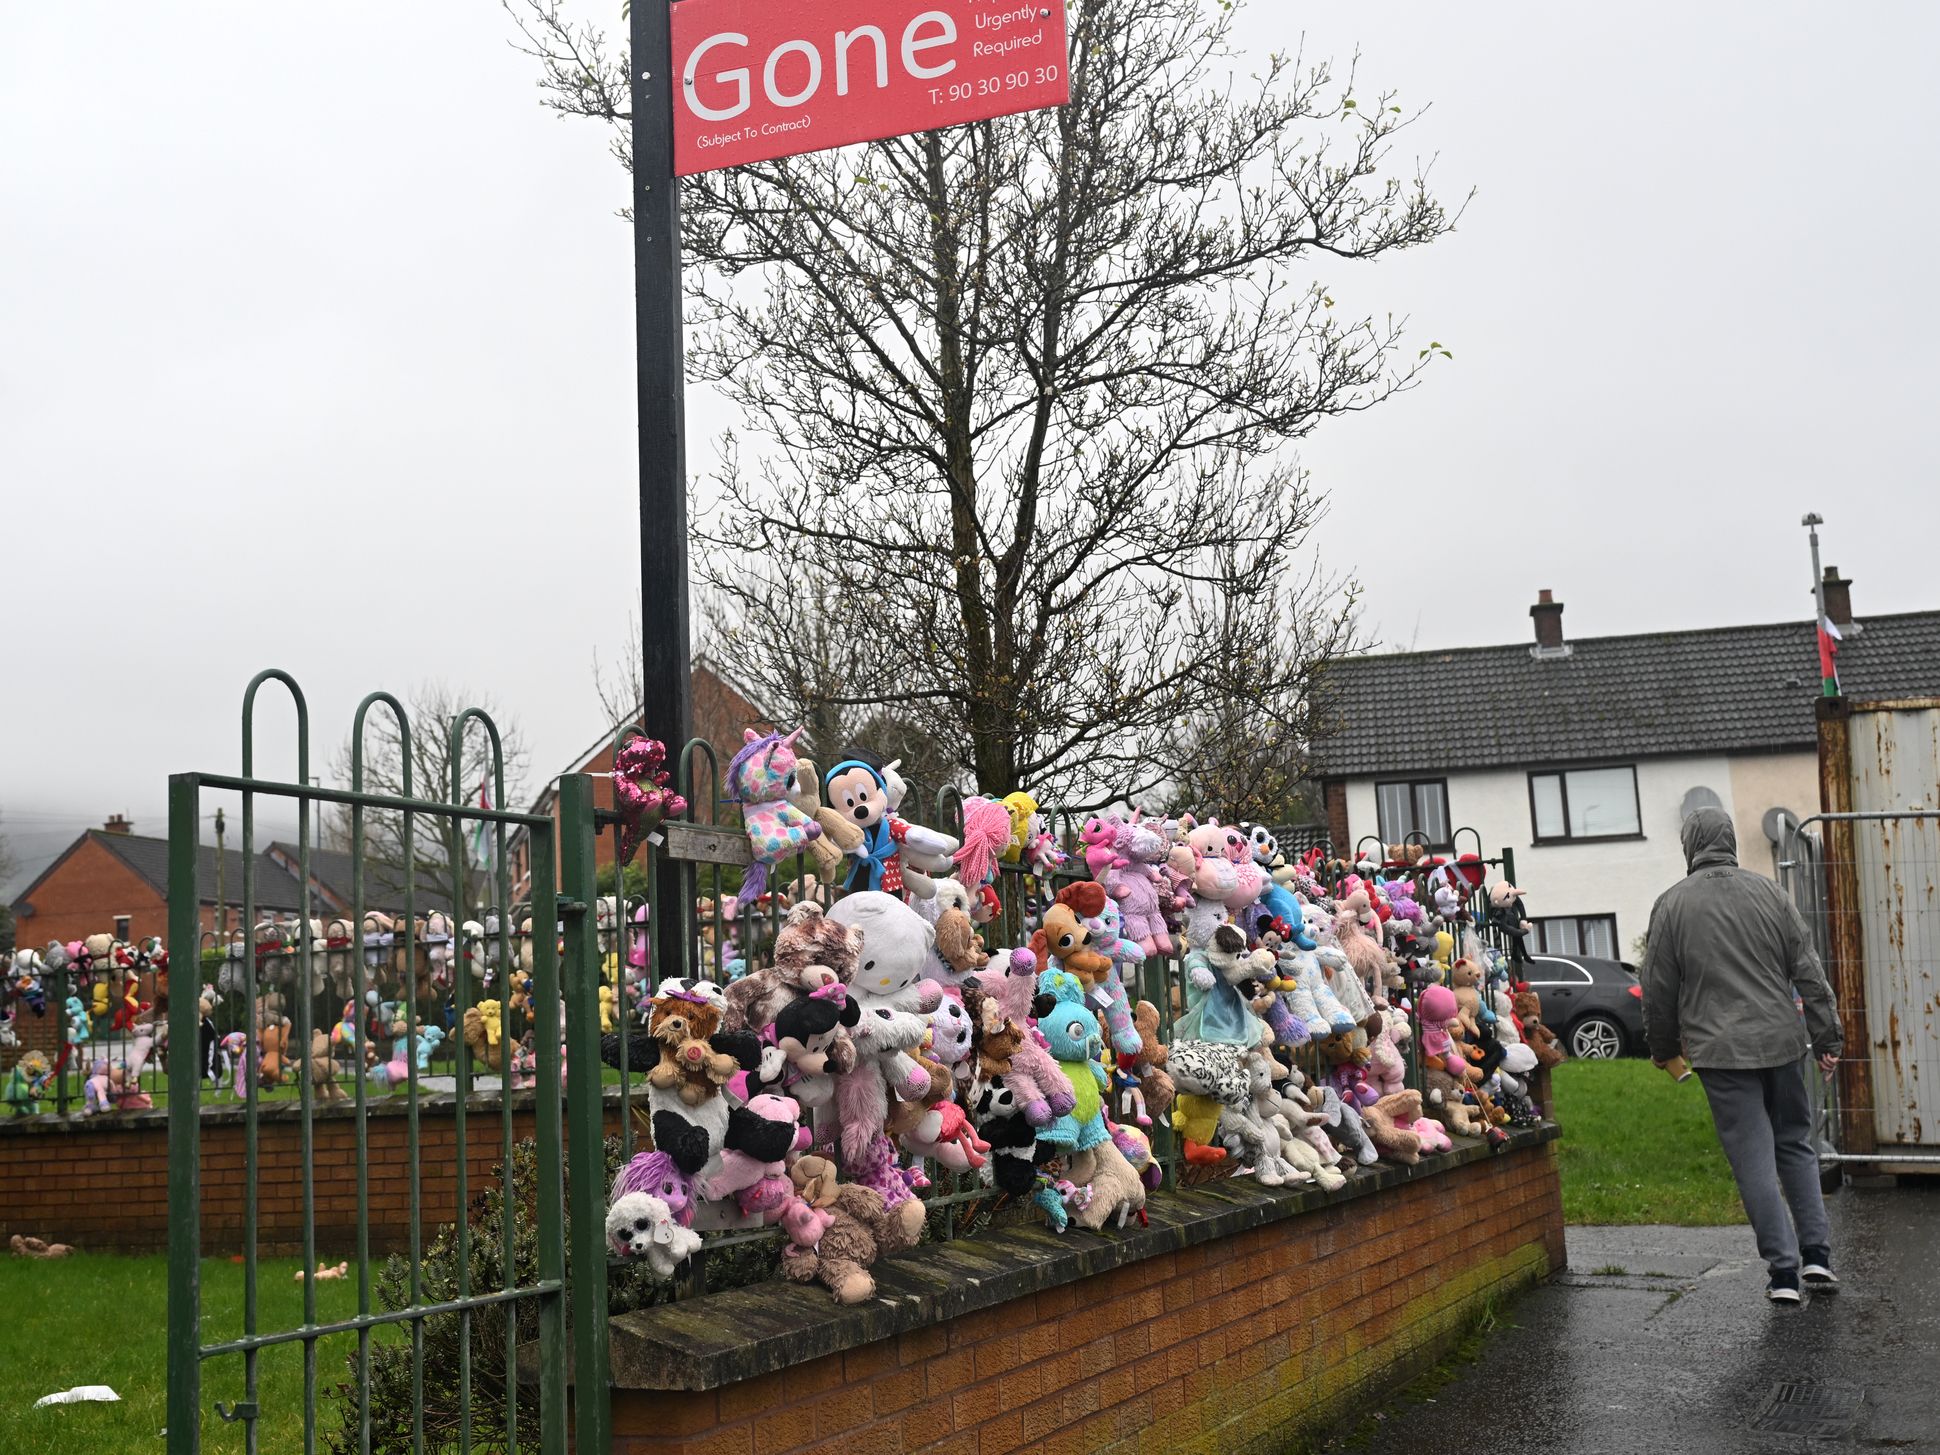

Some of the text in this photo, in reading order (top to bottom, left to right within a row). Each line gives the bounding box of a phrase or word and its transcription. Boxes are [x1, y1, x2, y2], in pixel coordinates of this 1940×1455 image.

[975, 3, 1037, 31] Urgently
[973, 28, 1042, 57] Required
[683, 10, 957, 122] Gone
[927, 65, 1058, 105] T: 90 30 90 30
[697, 114, 811, 149] (Subject To Contract)
